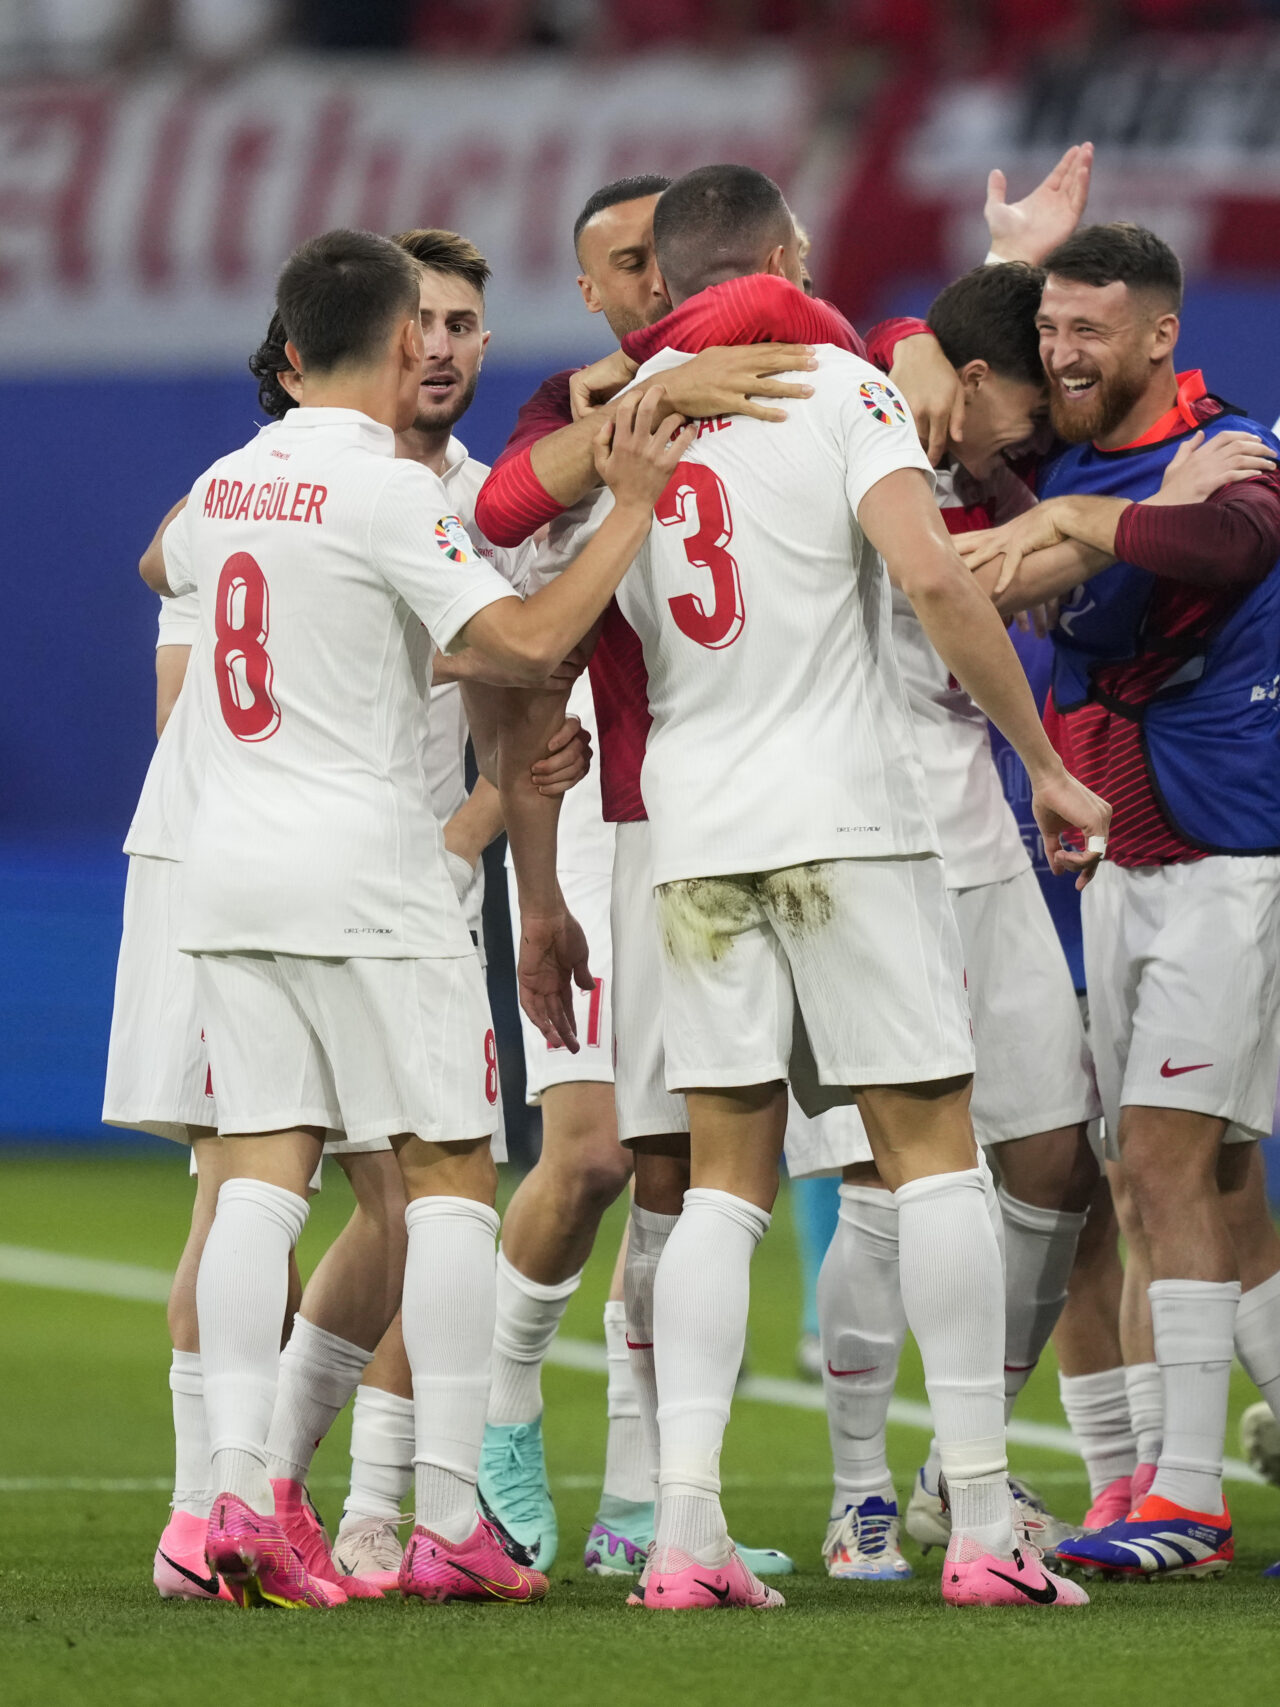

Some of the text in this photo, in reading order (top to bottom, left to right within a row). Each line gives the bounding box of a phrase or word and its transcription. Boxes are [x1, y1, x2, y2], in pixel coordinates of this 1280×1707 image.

[203, 476, 328, 525] ARDA GÜLER
[653, 461, 746, 651] 3
[214, 551, 282, 743] 8
[484, 1028, 498, 1106] 8
